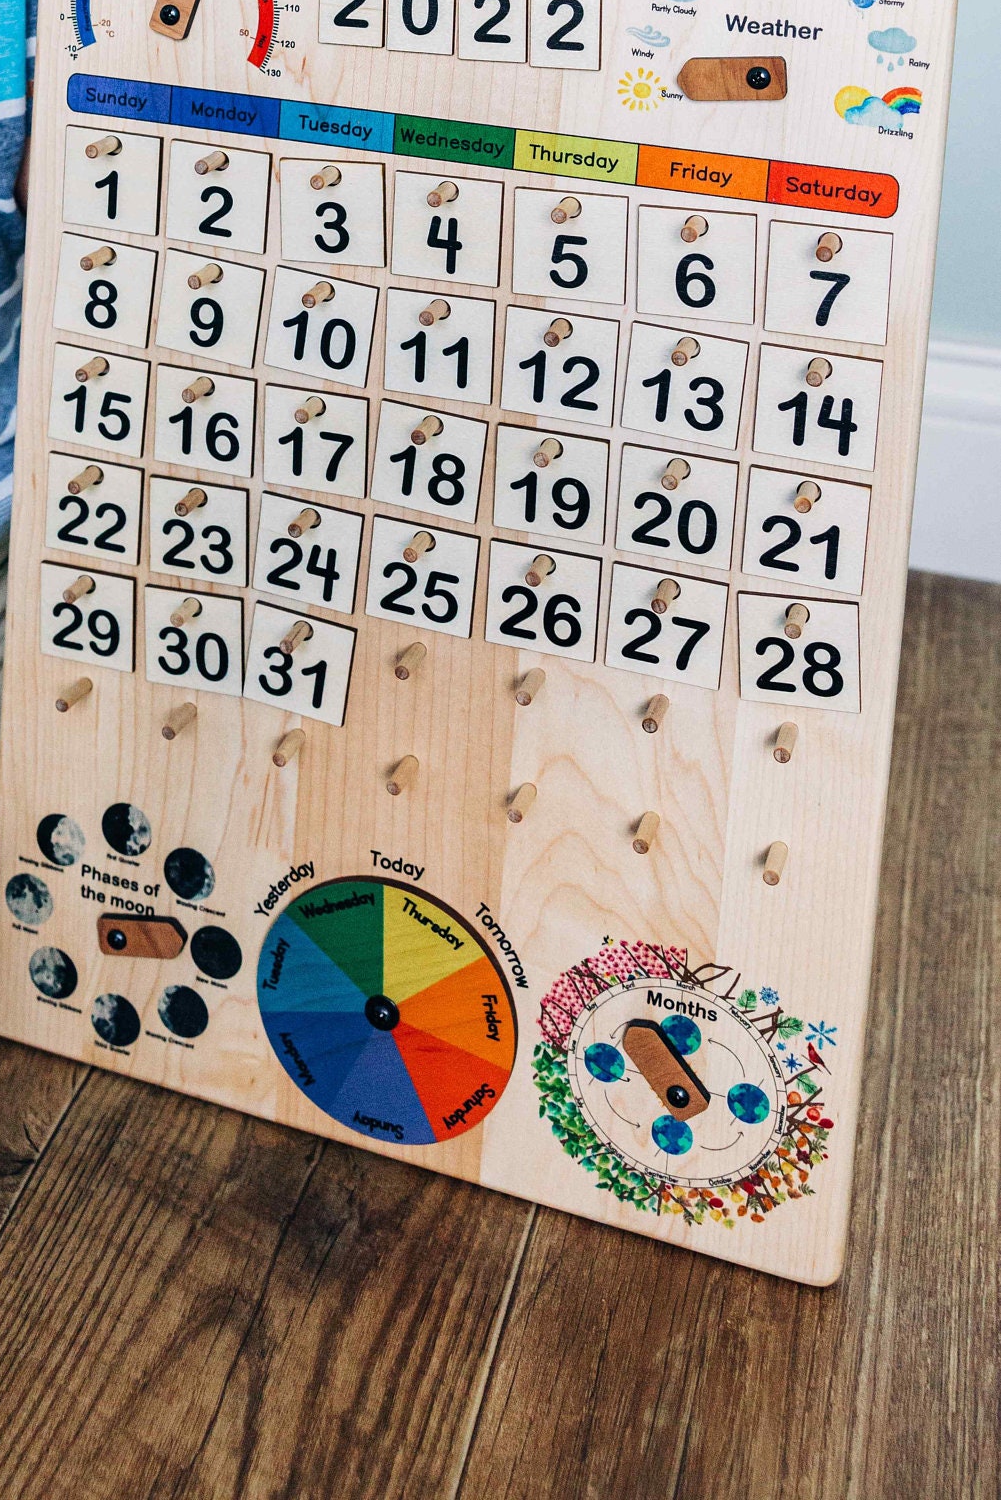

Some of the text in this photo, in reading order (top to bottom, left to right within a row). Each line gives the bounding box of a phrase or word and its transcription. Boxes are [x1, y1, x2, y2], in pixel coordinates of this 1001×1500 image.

[284, 4, 300, 12] 110
[651, 3, 697, 17] Partly Cloudy
[239, 29, 249, 37] 50
[725, 13, 823, 41] Weather
[281, 41, 295, 49] 120
[632, 48, 655, 60] Windy
[266, 69, 281, 77] 130
[908, 58, 931, 70] Rainy
[661, 89, 683, 101] Sunny
[85, 87, 882, 207] Sunday Monday Tuesday Wednesday Thursday Friday Saturday
[878, 125, 914, 140] Drizzling
[95, 170, 850, 326] 1 2 3 4 5 6 7
[84, 280, 858, 456] 8 9 10 11 12 13 14
[64, 385, 840, 580] 15 16 17 18 19 20 21
[57, 496, 844, 698] 22 23 24 25 26 27 28
[52, 602, 328, 709] 29 30 31
[81, 864, 161, 897] Phases of
[370, 850, 425, 881] Today
[81, 884, 155, 916] the moon
[254, 861, 316, 918] Yesterday
[298, 891, 376, 920] Wednesday
[403, 897, 465, 951] Thursday
[475, 902, 529, 989] Tomorrow
[263, 937, 291, 991] Tuesday
[676, 981, 696, 991] March
[481, 994, 502, 1042] Friday
[647, 990, 717, 1021] Months
[729, 1005, 752, 1030] February
[279, 1032, 316, 1086] Monday
[768, 1053, 782, 1078] January
[442, 1083, 496, 1130] Saturday
[353, 1110, 404, 1139] Sunday
[644, 1168, 678, 1183] September
